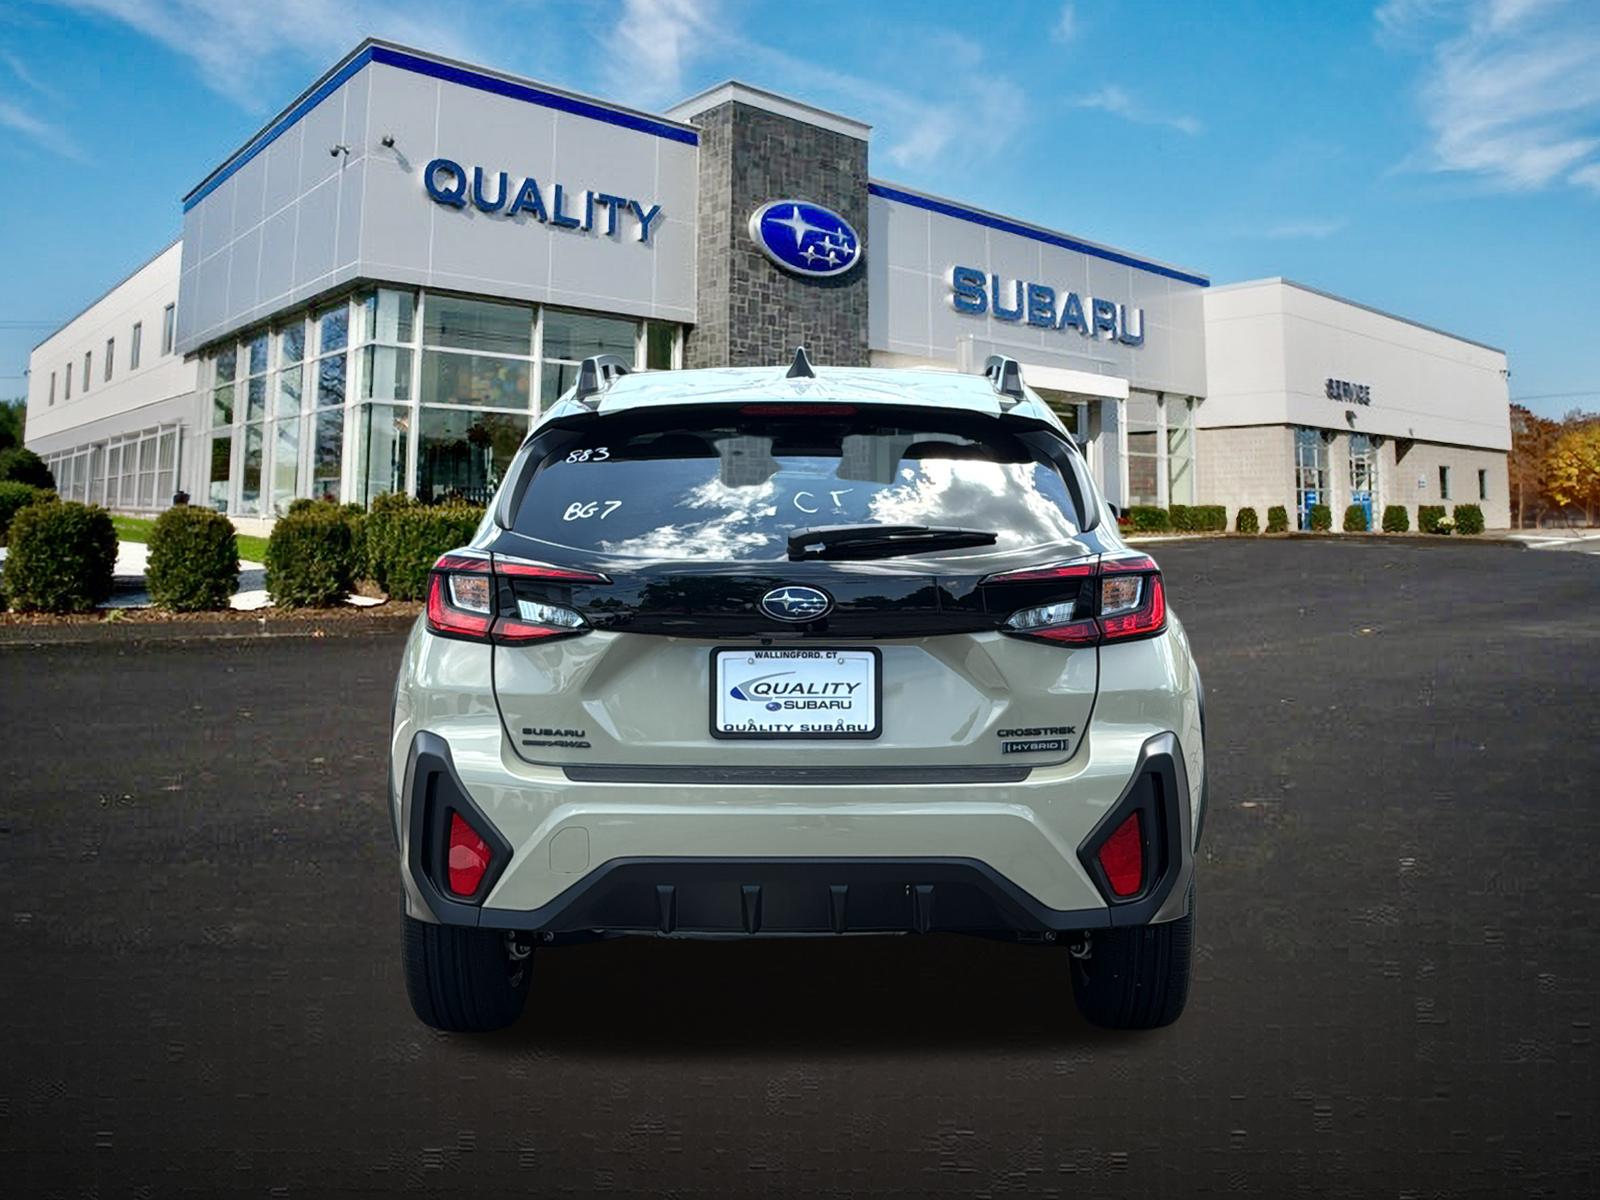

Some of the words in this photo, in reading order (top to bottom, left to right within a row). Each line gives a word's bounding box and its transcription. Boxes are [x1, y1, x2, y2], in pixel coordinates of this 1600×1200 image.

[423, 158, 662, 243] QUALITY
[951, 265, 1144, 346] SUBARU
[1325, 378, 1371, 406] SERVICE
[565, 446, 610, 464] 883
[826, 651, 838, 659] CT
[753, 682, 861, 695] QUALITY
[783, 701, 852, 710] SUBARU
[522, 728, 586, 737] SUBARU
[723, 723, 794, 732] QUALITY
[800, 723, 868, 732] SUBARU
[997, 726, 1076, 737] CROSSTREK
